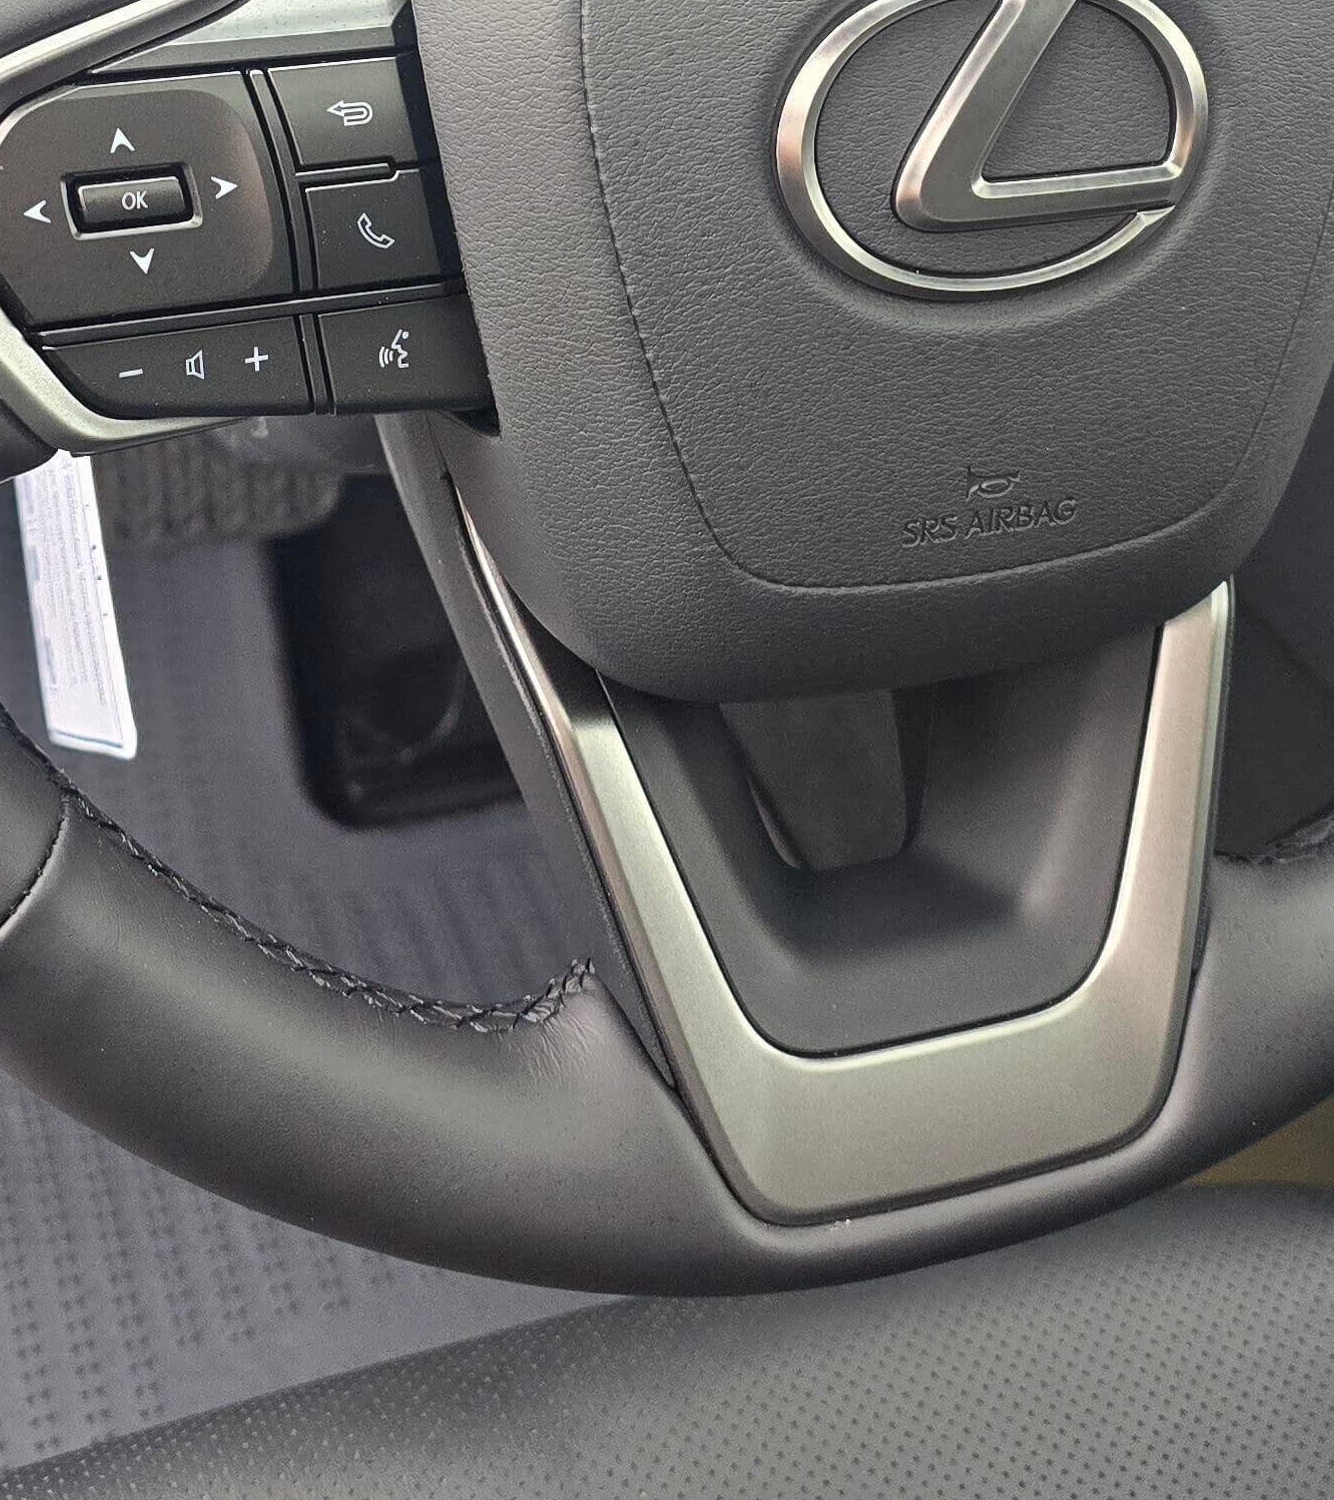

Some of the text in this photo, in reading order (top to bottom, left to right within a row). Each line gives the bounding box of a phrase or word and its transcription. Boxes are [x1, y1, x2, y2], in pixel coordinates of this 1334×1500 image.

[121, 190, 148, 211] OK
[902, 500, 1078, 549] SRS AIRBAG
